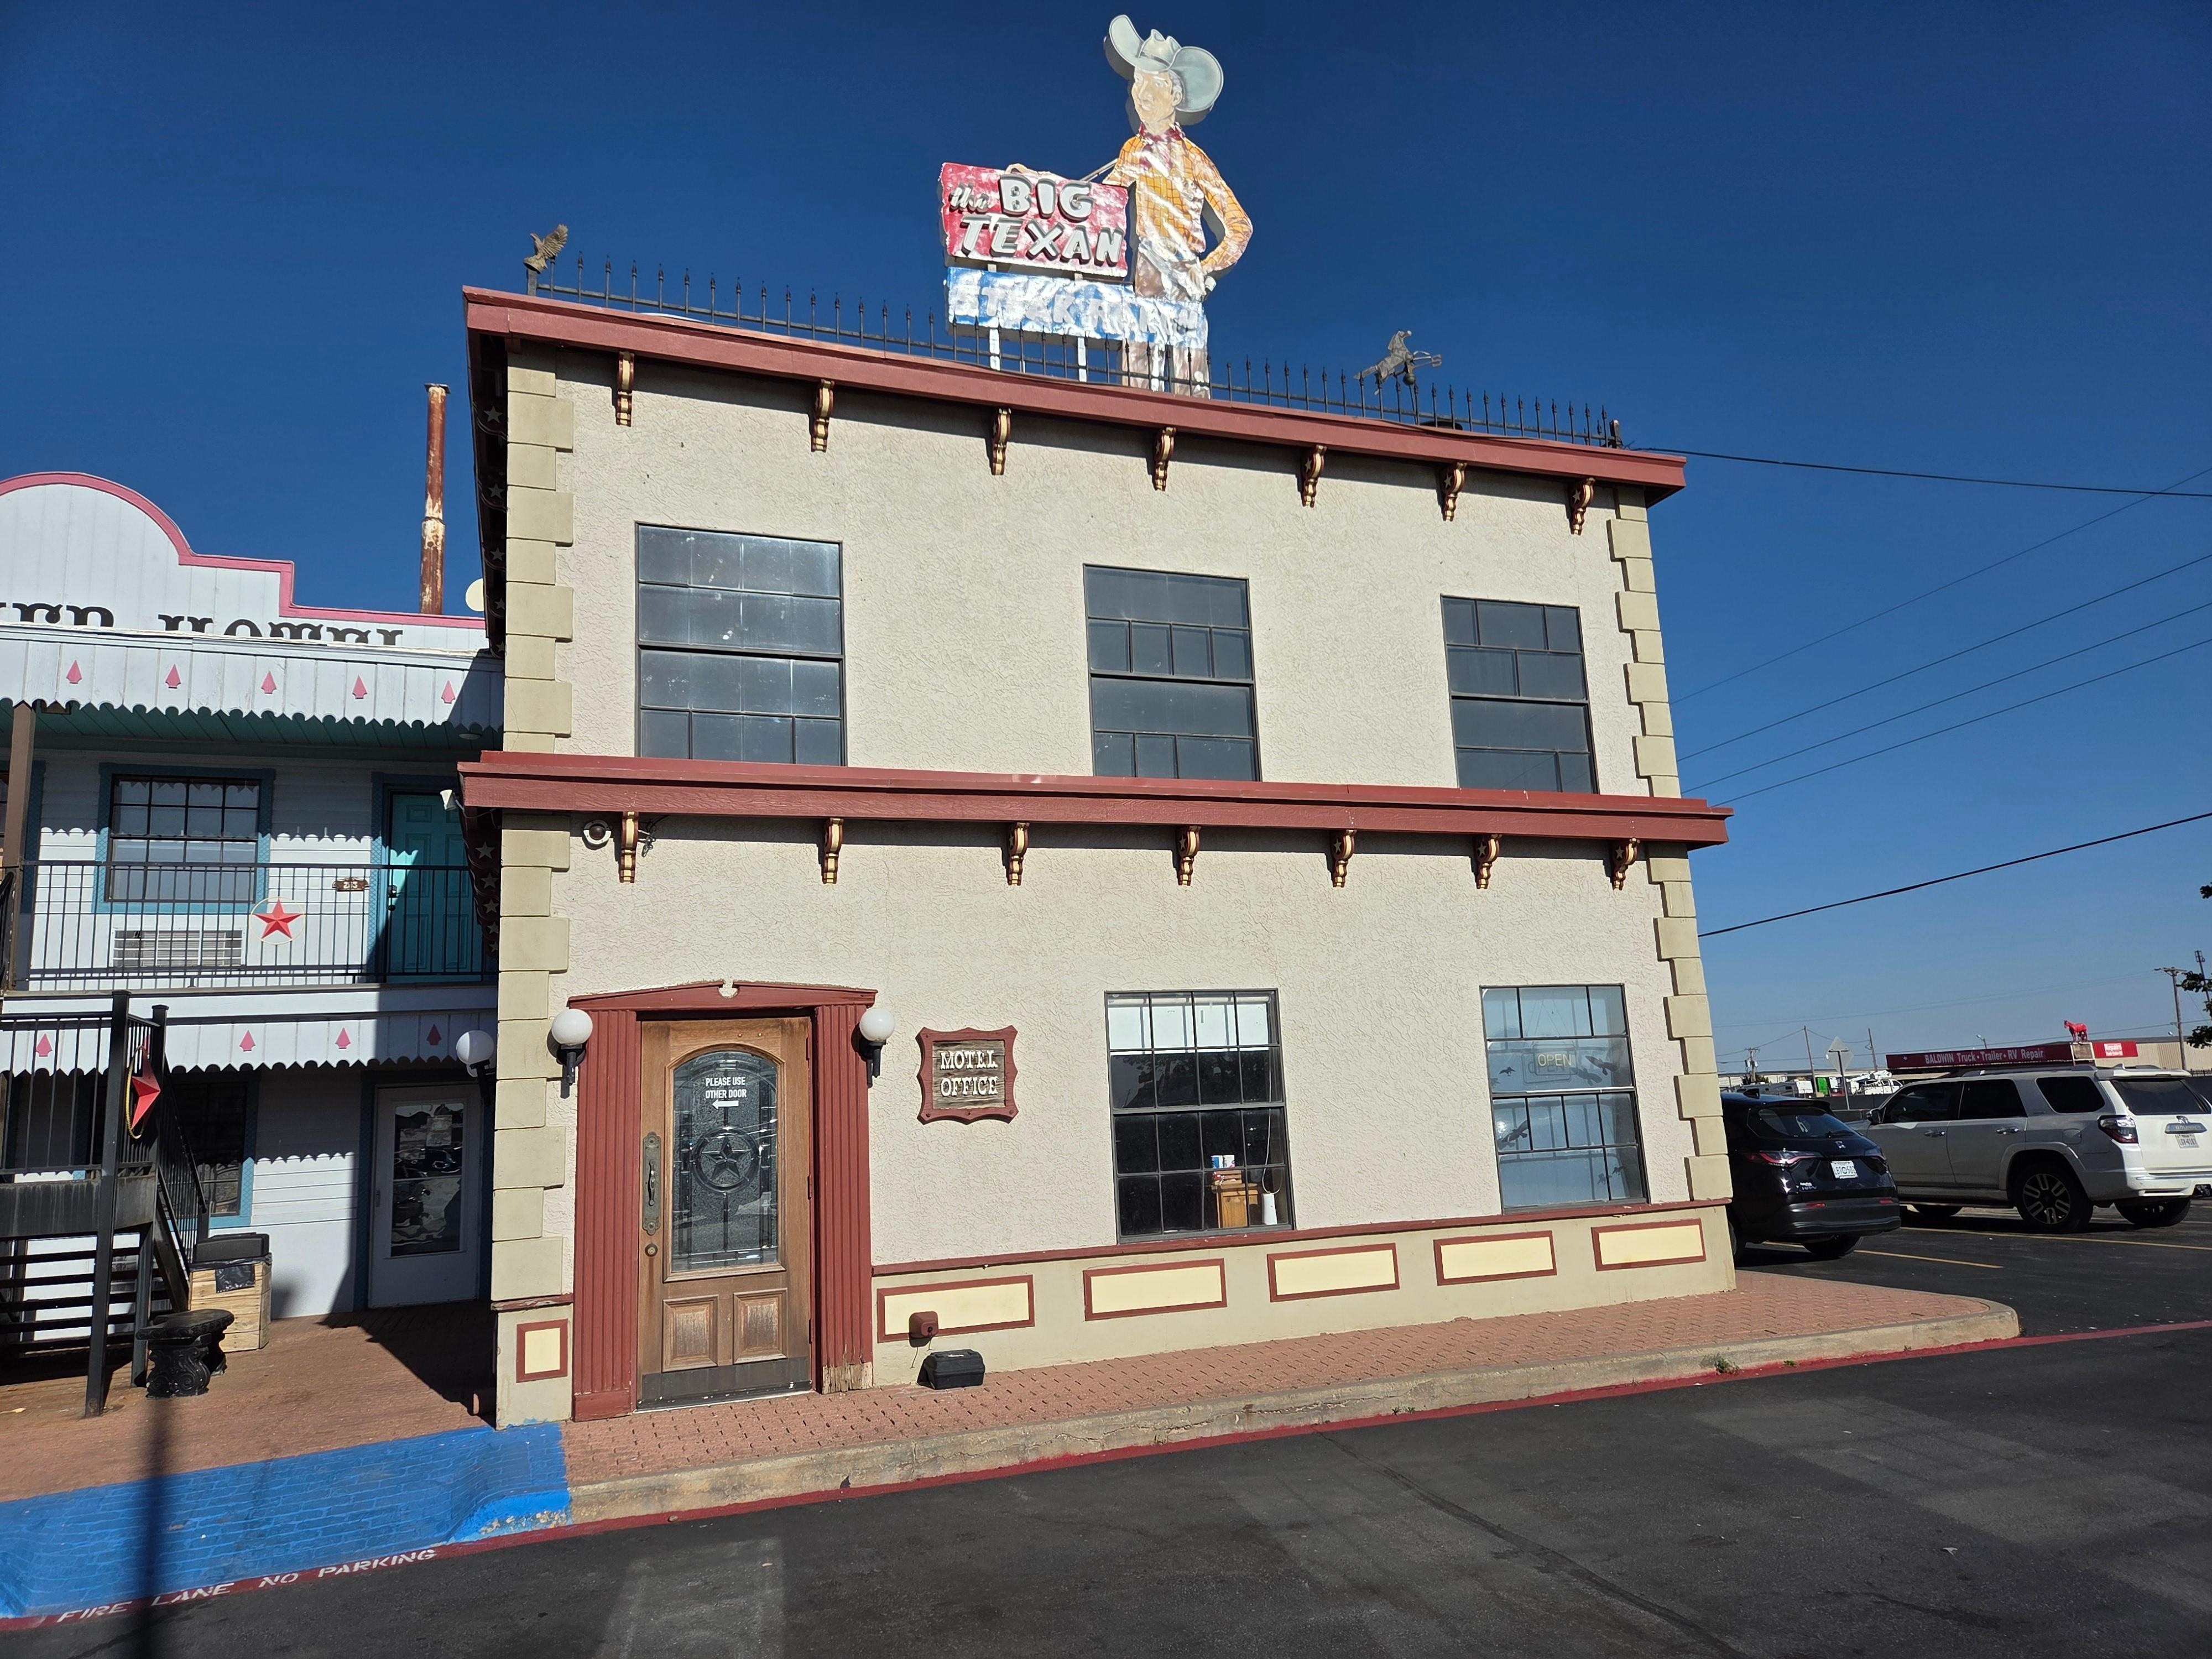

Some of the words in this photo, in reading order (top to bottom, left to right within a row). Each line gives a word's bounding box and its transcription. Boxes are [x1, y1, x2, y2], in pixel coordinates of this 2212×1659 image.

[949, 181, 990, 212] the
[998, 173, 1094, 221] BIG
[960, 215, 1124, 267] TEXAN
[940, 1050, 998, 1070] MOTEL
[1538, 1053, 1572, 1066] OPEN
[1924, 1052, 1954, 1065] BALDWIN
[1957, 1052, 1976, 1062] Truck
[1980, 1051, 2002, 1062] Trailer
[2007, 1049, 2017, 1060] RV
[2021, 1048, 2044, 1060] Repair
[706, 1077, 731, 1087] PLEASE
[732, 1076, 745, 1086] USE
[941, 1076, 998, 1097] OFFICE
[705, 1089, 727, 1099] OTHER
[728, 1089, 747, 1098] DOOR
[56, 1601, 133, 1623] FIRE
[150, 1583, 235, 1606] LANE
[258, 1573, 299, 1588] NO
[317, 1549, 437, 1578] PARKING
